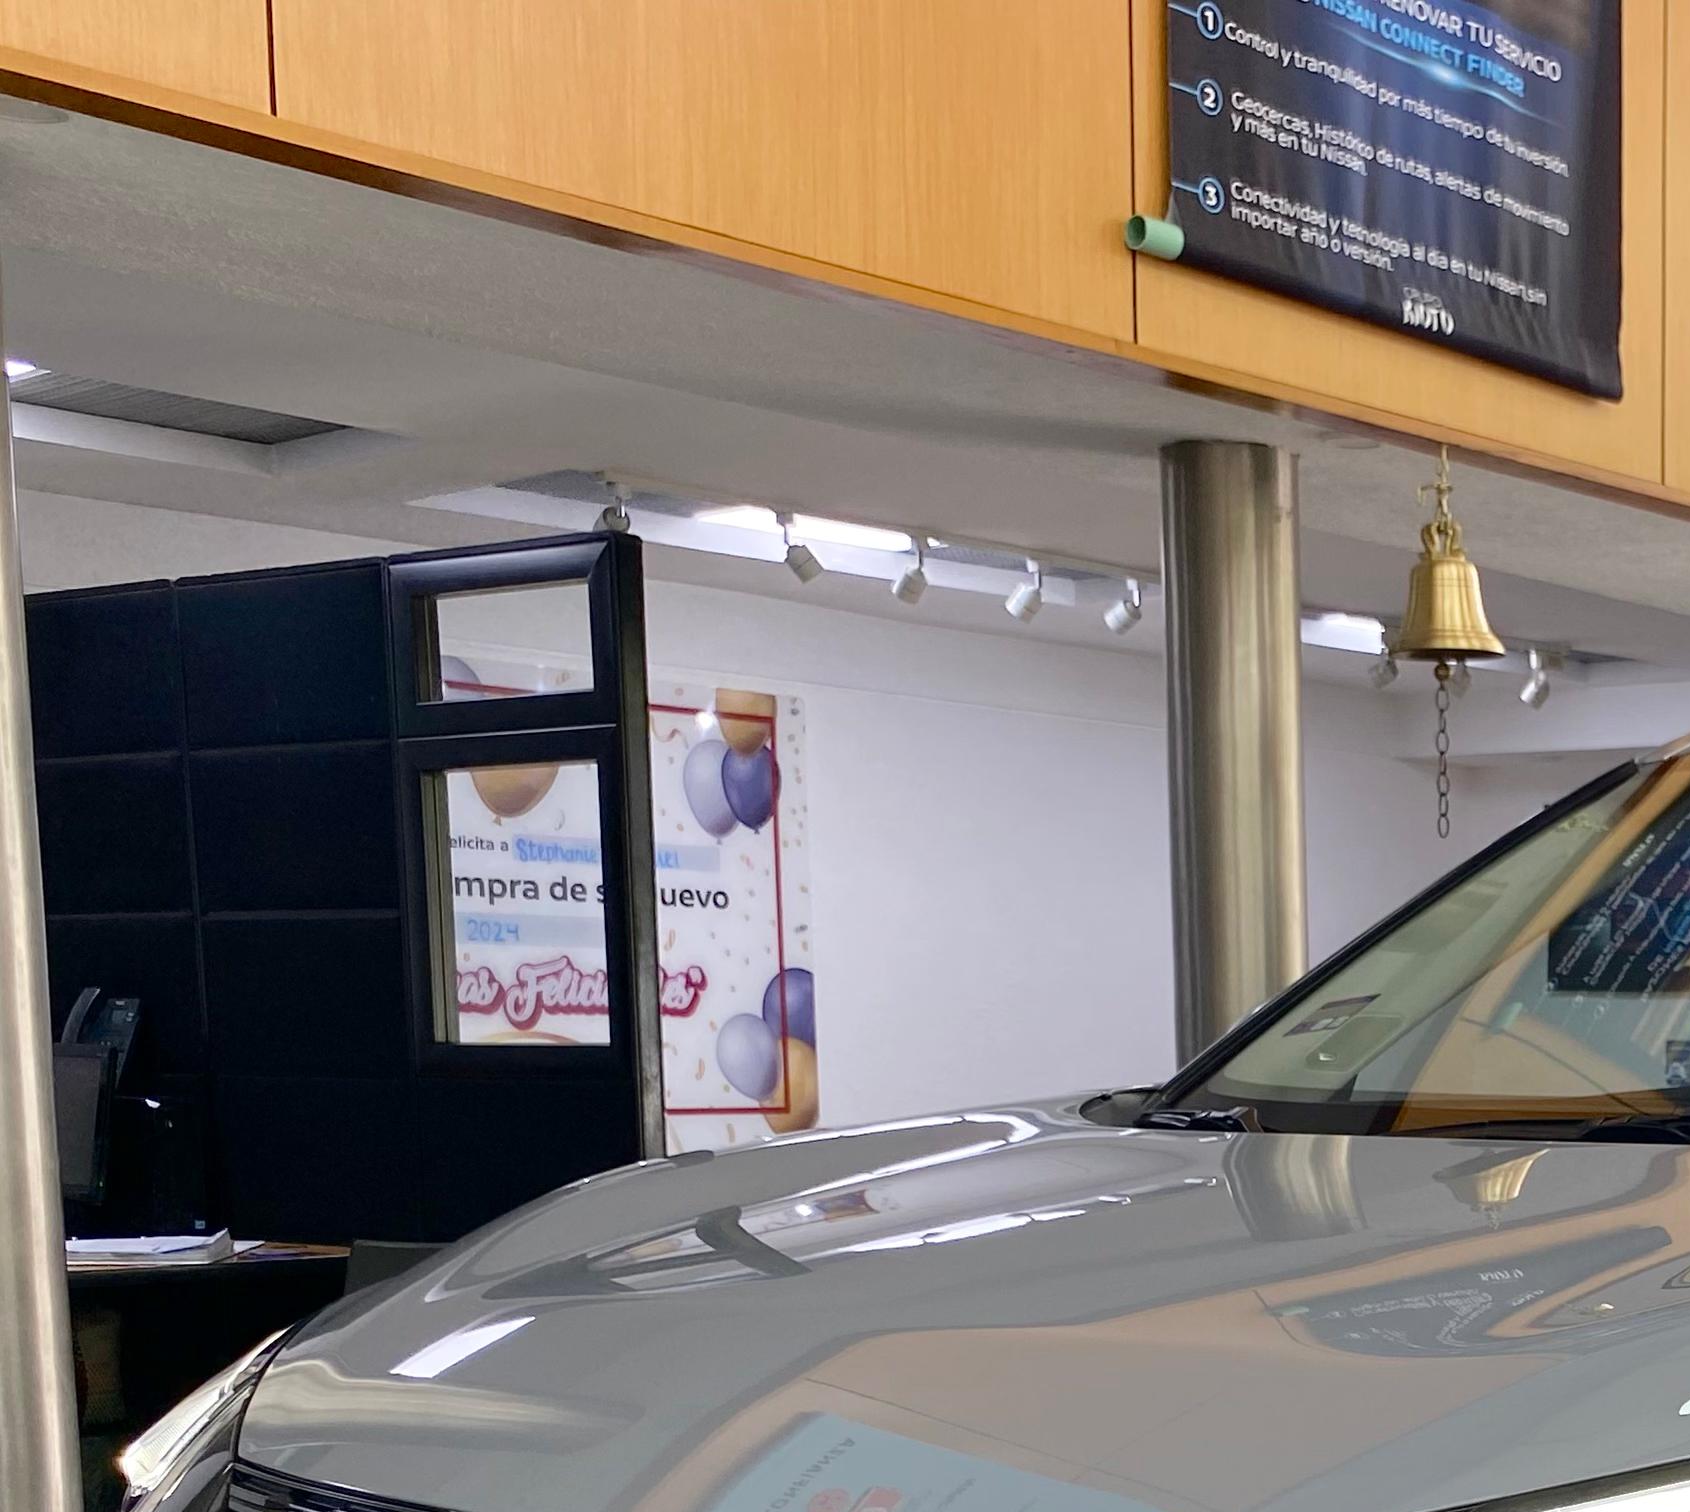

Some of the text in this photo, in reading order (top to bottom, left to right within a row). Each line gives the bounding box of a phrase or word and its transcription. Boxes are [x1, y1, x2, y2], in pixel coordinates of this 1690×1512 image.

[1380, 0, 1463, 37] ENOVAR
[1466, 20, 1494, 48] TU
[1224, 22, 1279, 59] Control
[1280, 47, 1292, 68] y
[1294, 51, 1378, 98] tranquilidad
[1378, 87, 1401, 108] por
[1402, 98, 1433, 121] más
[1433, 107, 1485, 139] tiempo
[1380, 17, 1464, 69] CONNECT
[1467, 54, 1525, 98] FINDER
[1230, 112, 1243, 133] y
[1244, 117, 1277, 143] más
[1277, 131, 1299, 151] en
[1301, 137, 1319, 158] tu
[1375, 148, 1394, 168] de
[1483, 186, 1503, 208] de
[1231, 201, 1299, 239] importar
[1300, 226, 1329, 249] año
[1330, 238, 1342, 254] o
[1231, 181, 1328, 228] Conectividad
[1328, 216, 1341, 236] y
[1412, 244, 1426, 264] al
[1450, 257, 1467, 277] en
[449, 835, 510, 853] elicita a
[454, 875, 540, 906] mpra
[549, 875, 588, 902] de
[660, 886, 730, 910] uevo
[465, 919, 521, 943] 2024
